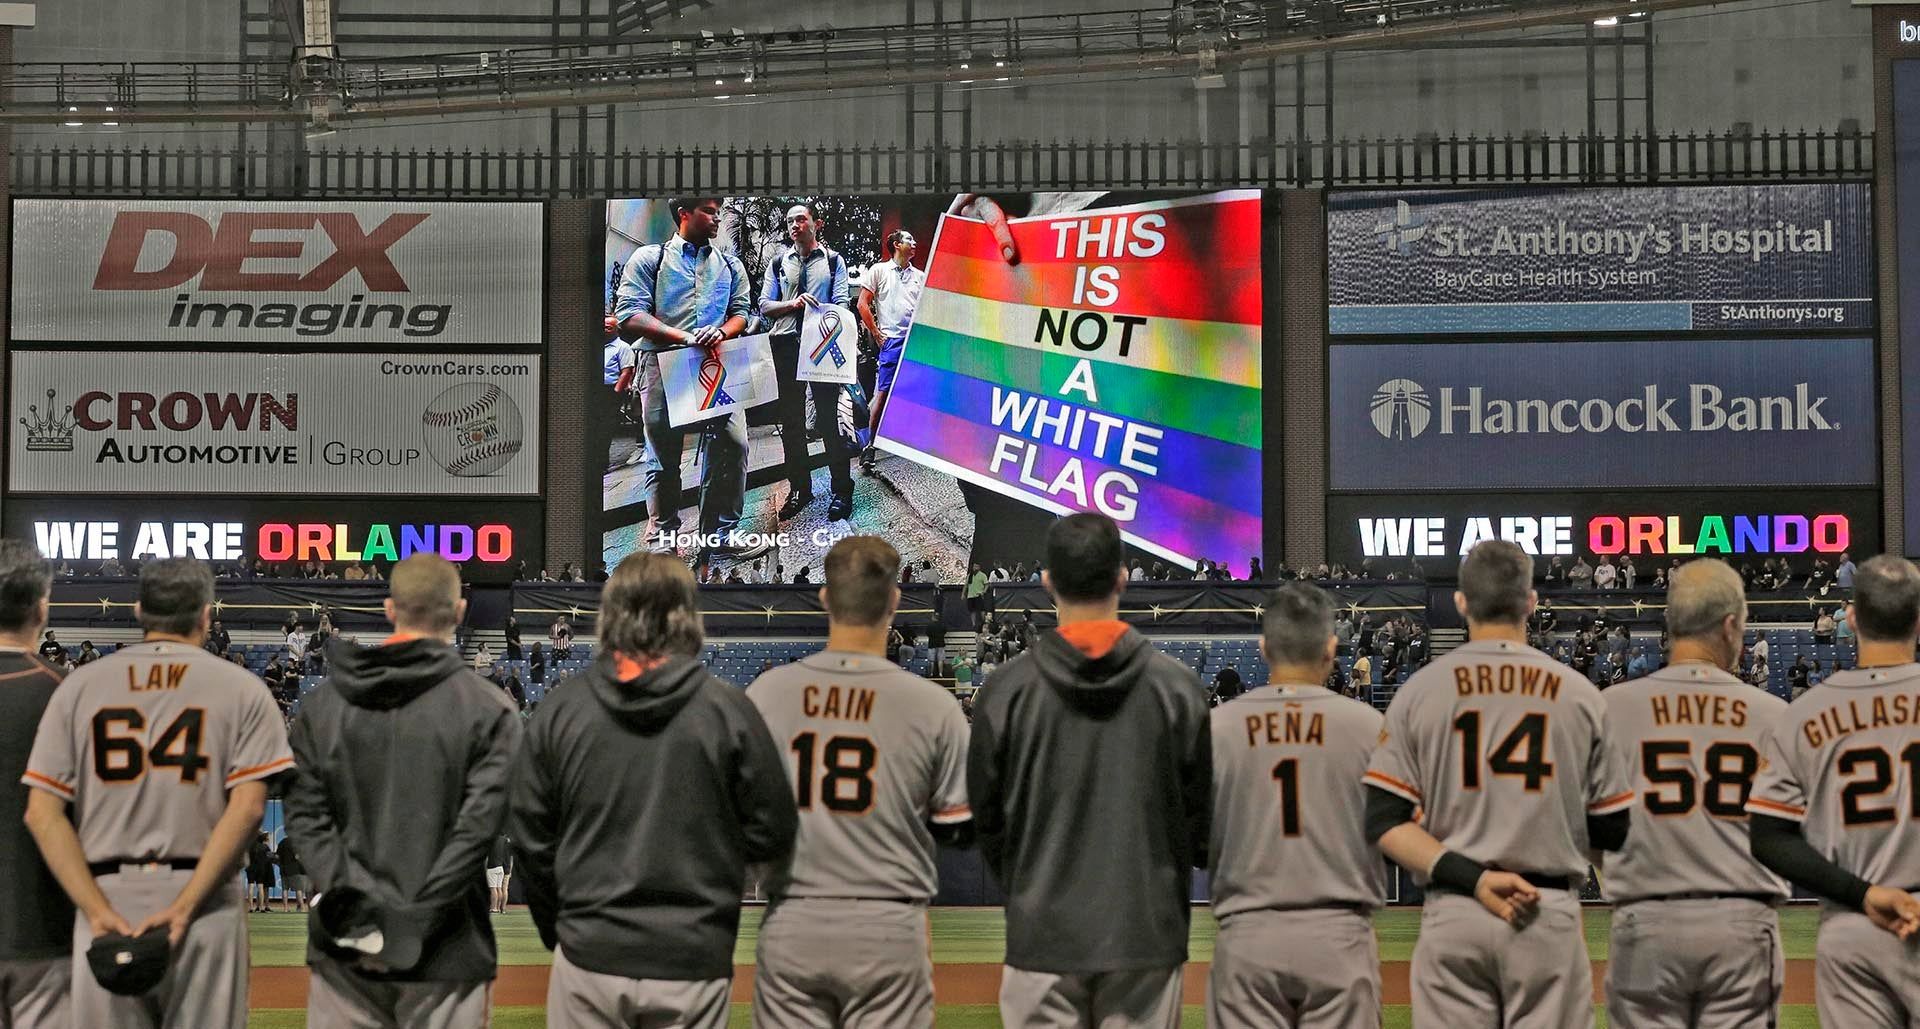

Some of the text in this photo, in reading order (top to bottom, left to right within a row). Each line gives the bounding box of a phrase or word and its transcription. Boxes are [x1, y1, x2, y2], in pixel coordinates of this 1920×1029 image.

[92, 210, 432, 292] DEX
[1050, 213, 1167, 259] THIS
[1433, 219, 1833, 264] St. Anthony's Hospital
[1073, 265, 1120, 306] IS
[1434, 269, 1657, 291] BayCare Health System
[167, 294, 452, 336] imaging
[1034, 307, 1147, 358] NOT
[1721, 303, 1845, 323] StAnthonys.org
[380, 359, 530, 376] CrownCars.com
[1058, 357, 1098, 402] A
[72, 390, 298, 431] CROWN
[837, 387, 858, 444] NIKE
[1439, 382, 1833, 434] Hancock Bank
[990, 386, 1166, 476] WHITE
[988, 436, 1139, 522] FLAG
[34, 521, 513, 562] WE ARE ORLANDO
[1358, 513, 1850, 557] WE ARE ORLANDO
[127, 663, 189, 693] LAW
[1453, 664, 1563, 701] BROWN
[803, 684, 876, 722] CAIN
[1245, 702, 1326, 748] PEÑA
[1651, 694, 1749, 729] HAYES
[91, 706, 211, 785] 64
[1453, 709, 1554, 794] 14
[789, 729, 878, 816] 18
[1639, 738, 1760, 819] 58
[1271, 756, 1303, 838] 1
